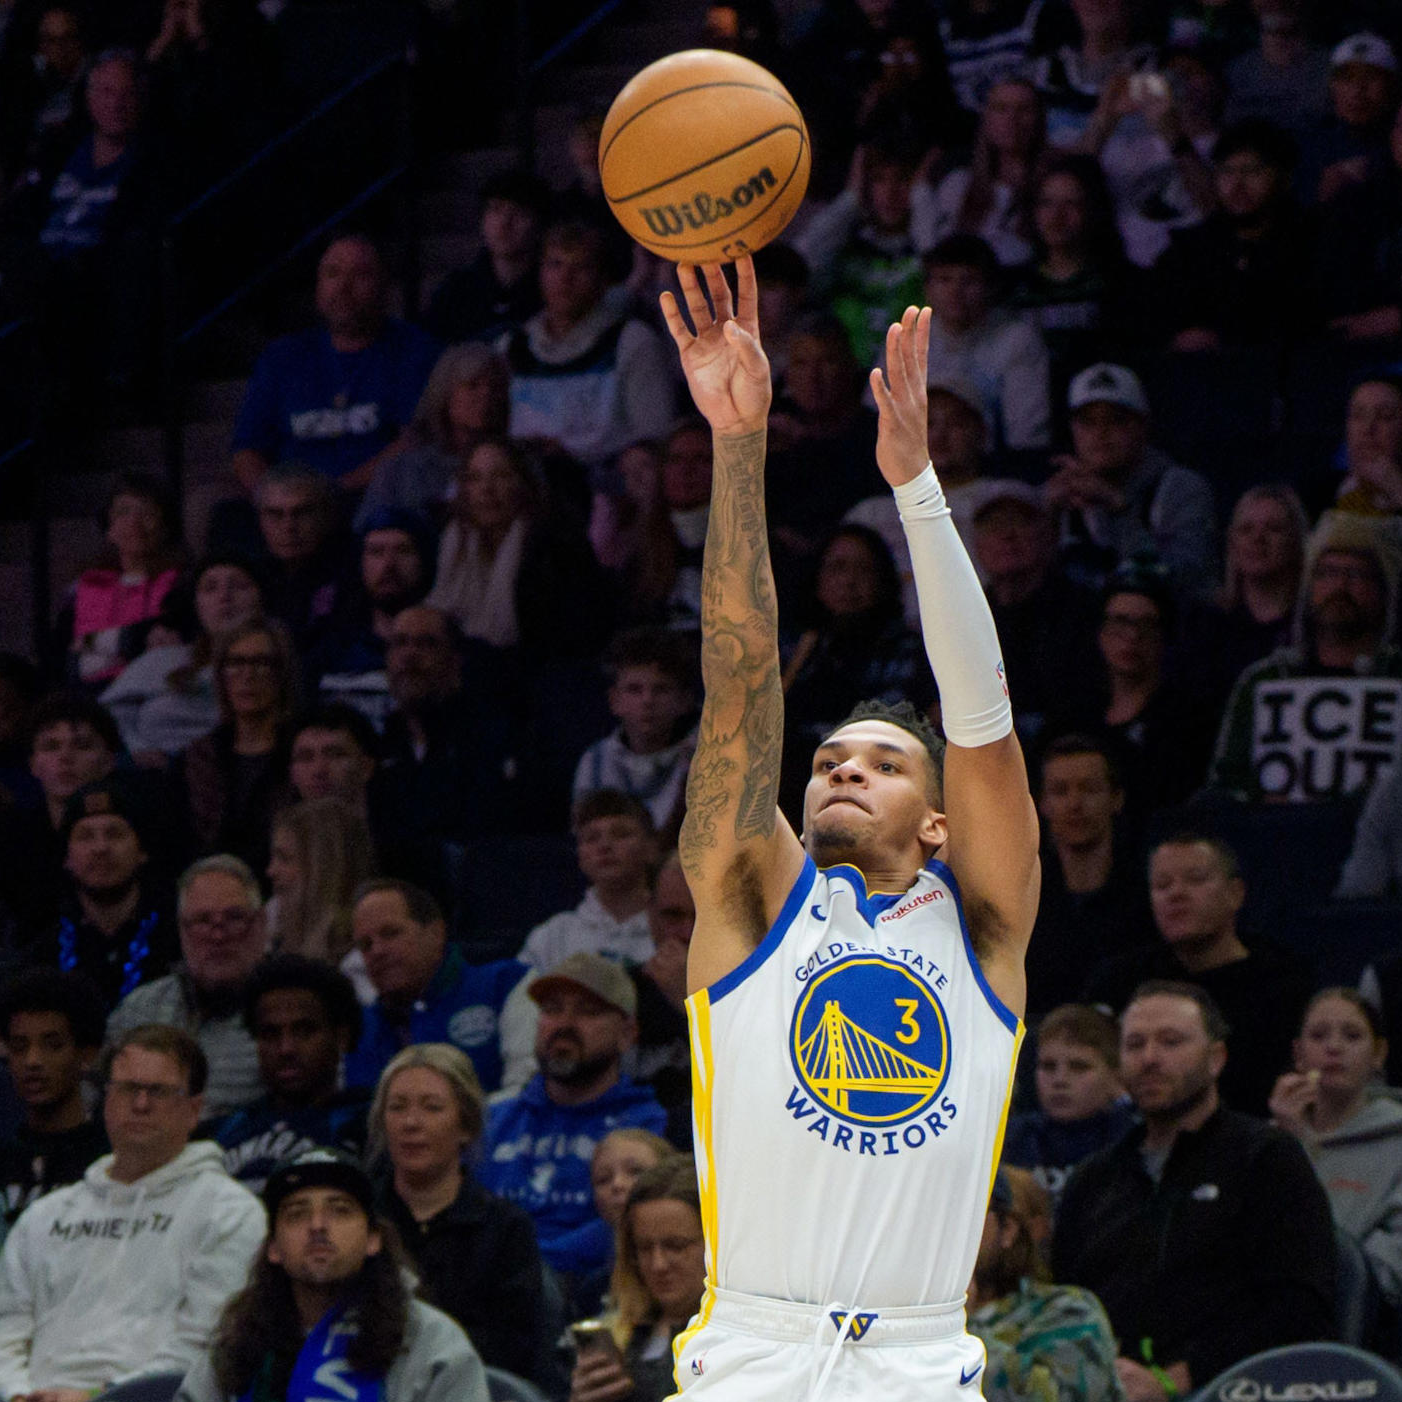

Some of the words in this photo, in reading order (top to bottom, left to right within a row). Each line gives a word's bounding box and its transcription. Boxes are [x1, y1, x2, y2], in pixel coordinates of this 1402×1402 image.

[638, 166, 778, 236] Wilson
[1261, 690, 1397, 743] ICE
[1257, 750, 1392, 797] OUT
[880, 889, 944, 924] Rakuten
[795, 942, 875, 983] GOLDE
[887, 946, 948, 990] STATE
[894, 998, 921, 1045] 3
[785, 1085, 958, 1156] WARRIORS
[1264, 1379, 1378, 1402] LEXUS
